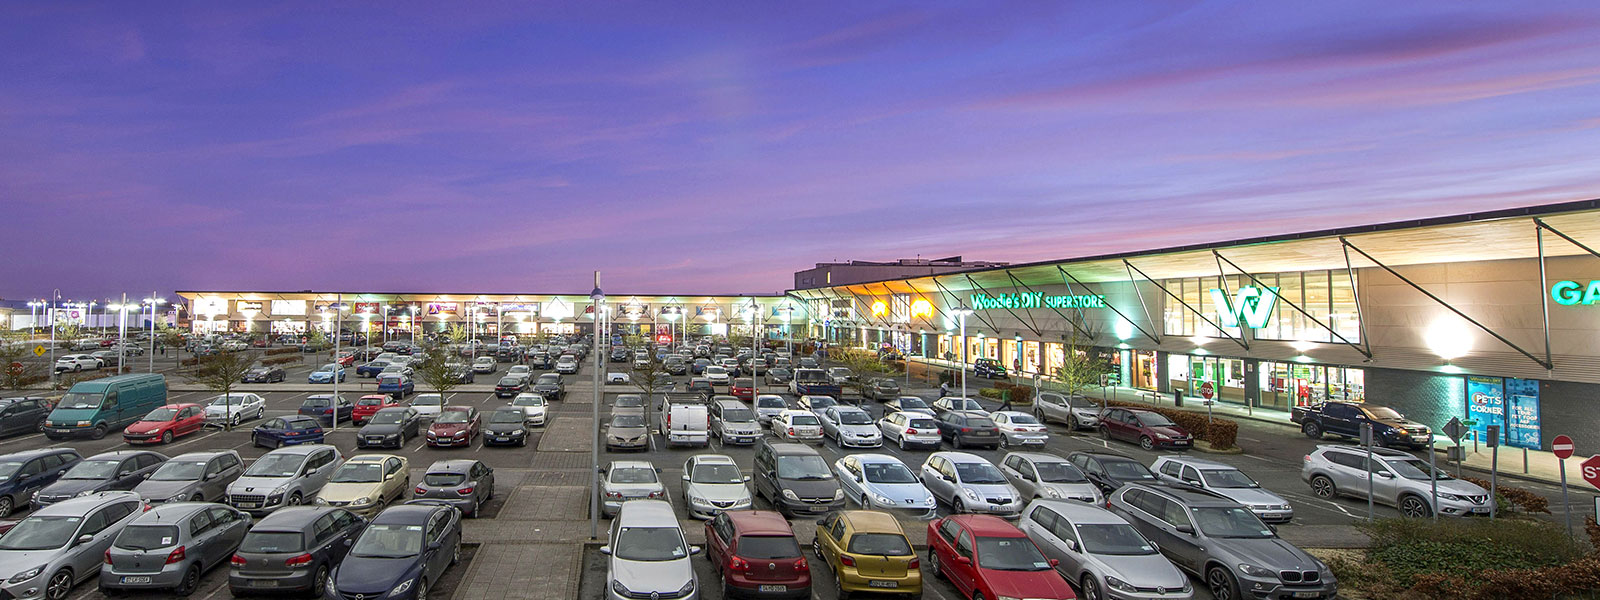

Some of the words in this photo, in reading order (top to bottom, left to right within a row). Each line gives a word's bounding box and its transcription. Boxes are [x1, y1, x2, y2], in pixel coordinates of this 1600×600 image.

[1551, 280, 1600, 305] GA
[970, 292, 1020, 310] Woodie's
[1021, 291, 1044, 308] DIY
[1045, 295, 1106, 308] SUPERSTORE
[1476, 394, 1502, 405] PETS
[1470, 405, 1504, 415] CORNER
